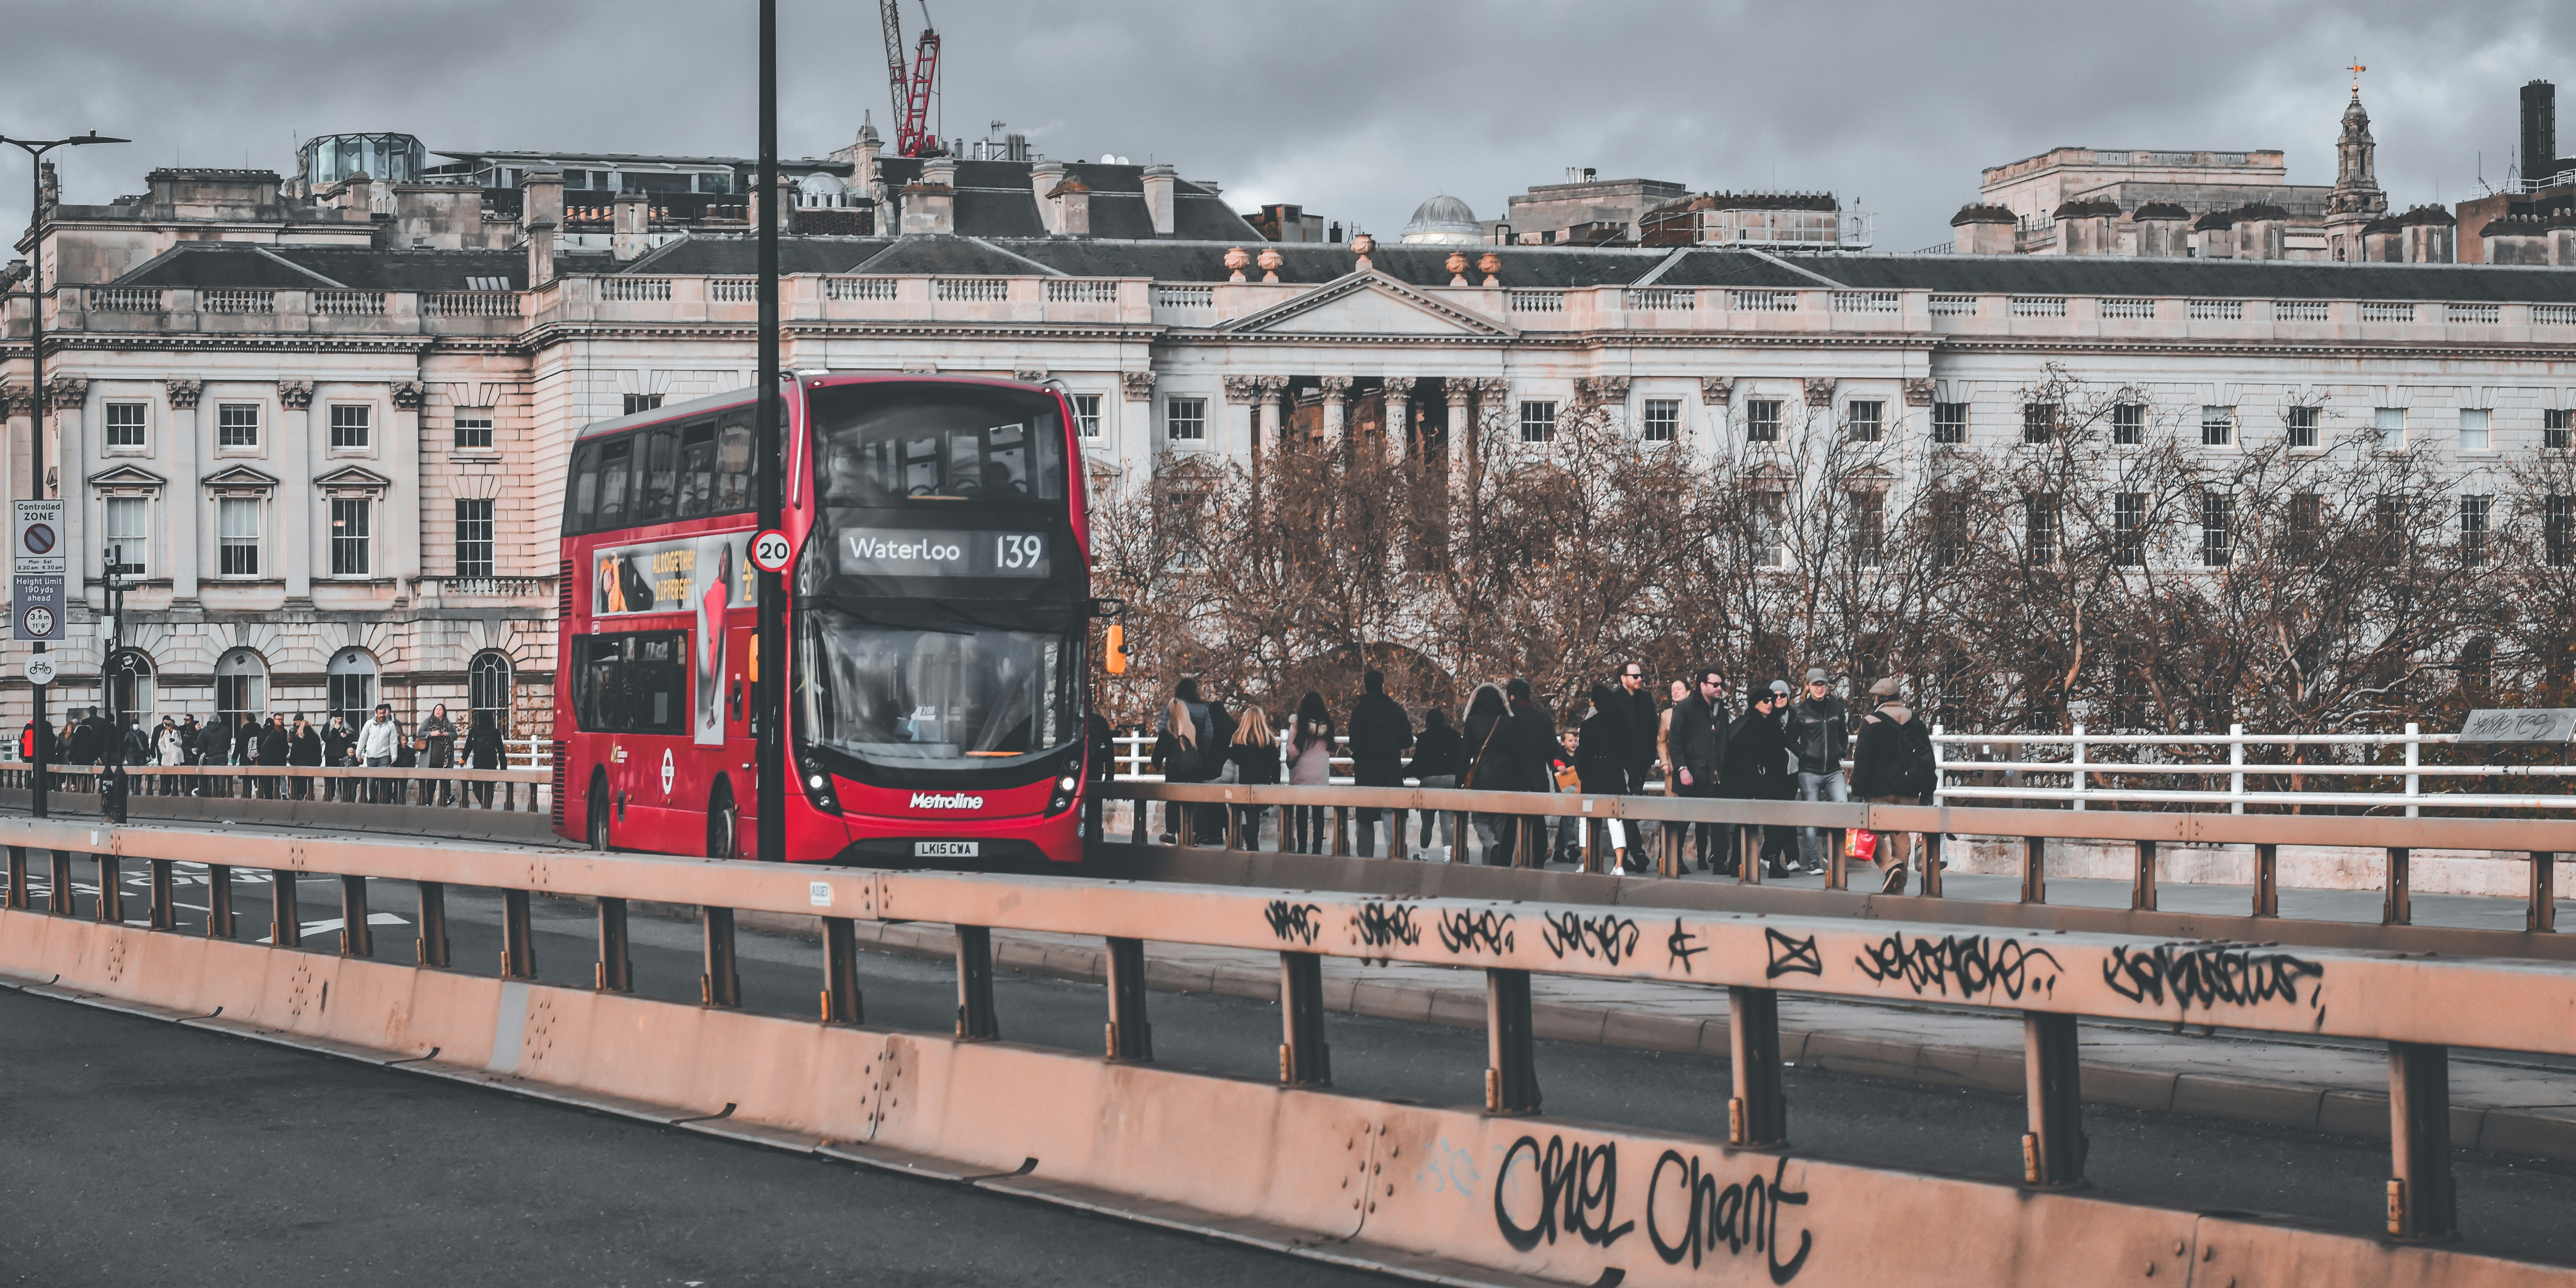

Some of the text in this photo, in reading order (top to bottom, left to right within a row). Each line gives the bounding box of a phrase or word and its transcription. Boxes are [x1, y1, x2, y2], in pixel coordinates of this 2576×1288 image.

[24, 512, 54, 520] ZONE
[759, 543, 788, 559] 20
[849, 537, 960, 560] Waterloo
[997, 535, 1041, 568] 139
[16, 577, 42, 586] Height
[40, 586, 54, 594] yds
[909, 792, 983, 809] Metroline
[922, 844, 971, 854] LK15 CWA
